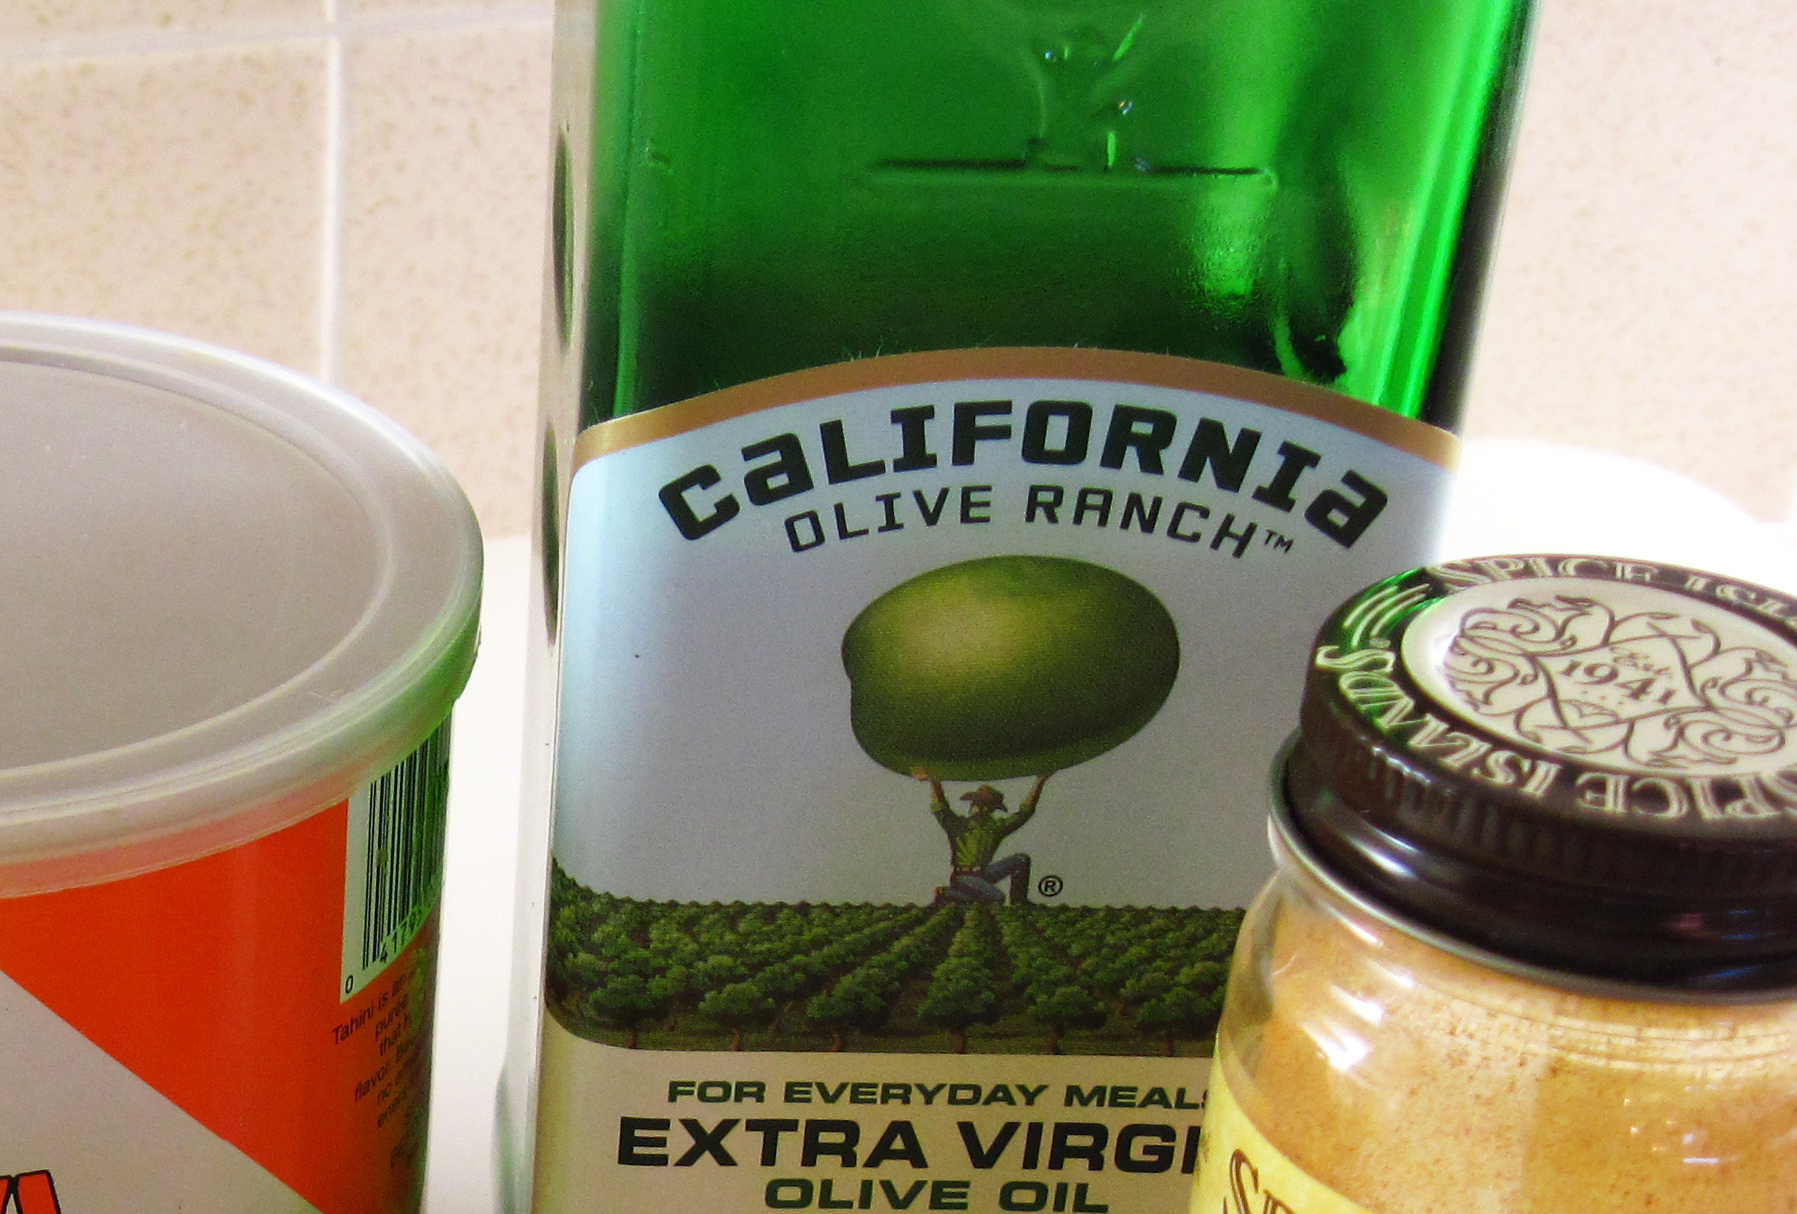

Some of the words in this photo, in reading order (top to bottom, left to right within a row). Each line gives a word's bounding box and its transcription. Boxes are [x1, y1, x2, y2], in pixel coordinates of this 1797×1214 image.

[784, 484, 994, 553] OLIVE
[1558, 659, 1678, 705] 1941
[1315, 645, 1562, 797] ISLANDS
[667, 1080, 767, 1105] FOR
[783, 1081, 1050, 1108] EVERYDAY
[1064, 1084, 1208, 1110] MEAL
[616, 1115, 930, 1169] EXTRA
[956, 1121, 1202, 1175] VIRGI
[764, 1177, 972, 1213] OLIVE
[998, 1181, 1111, 1214] OIL
